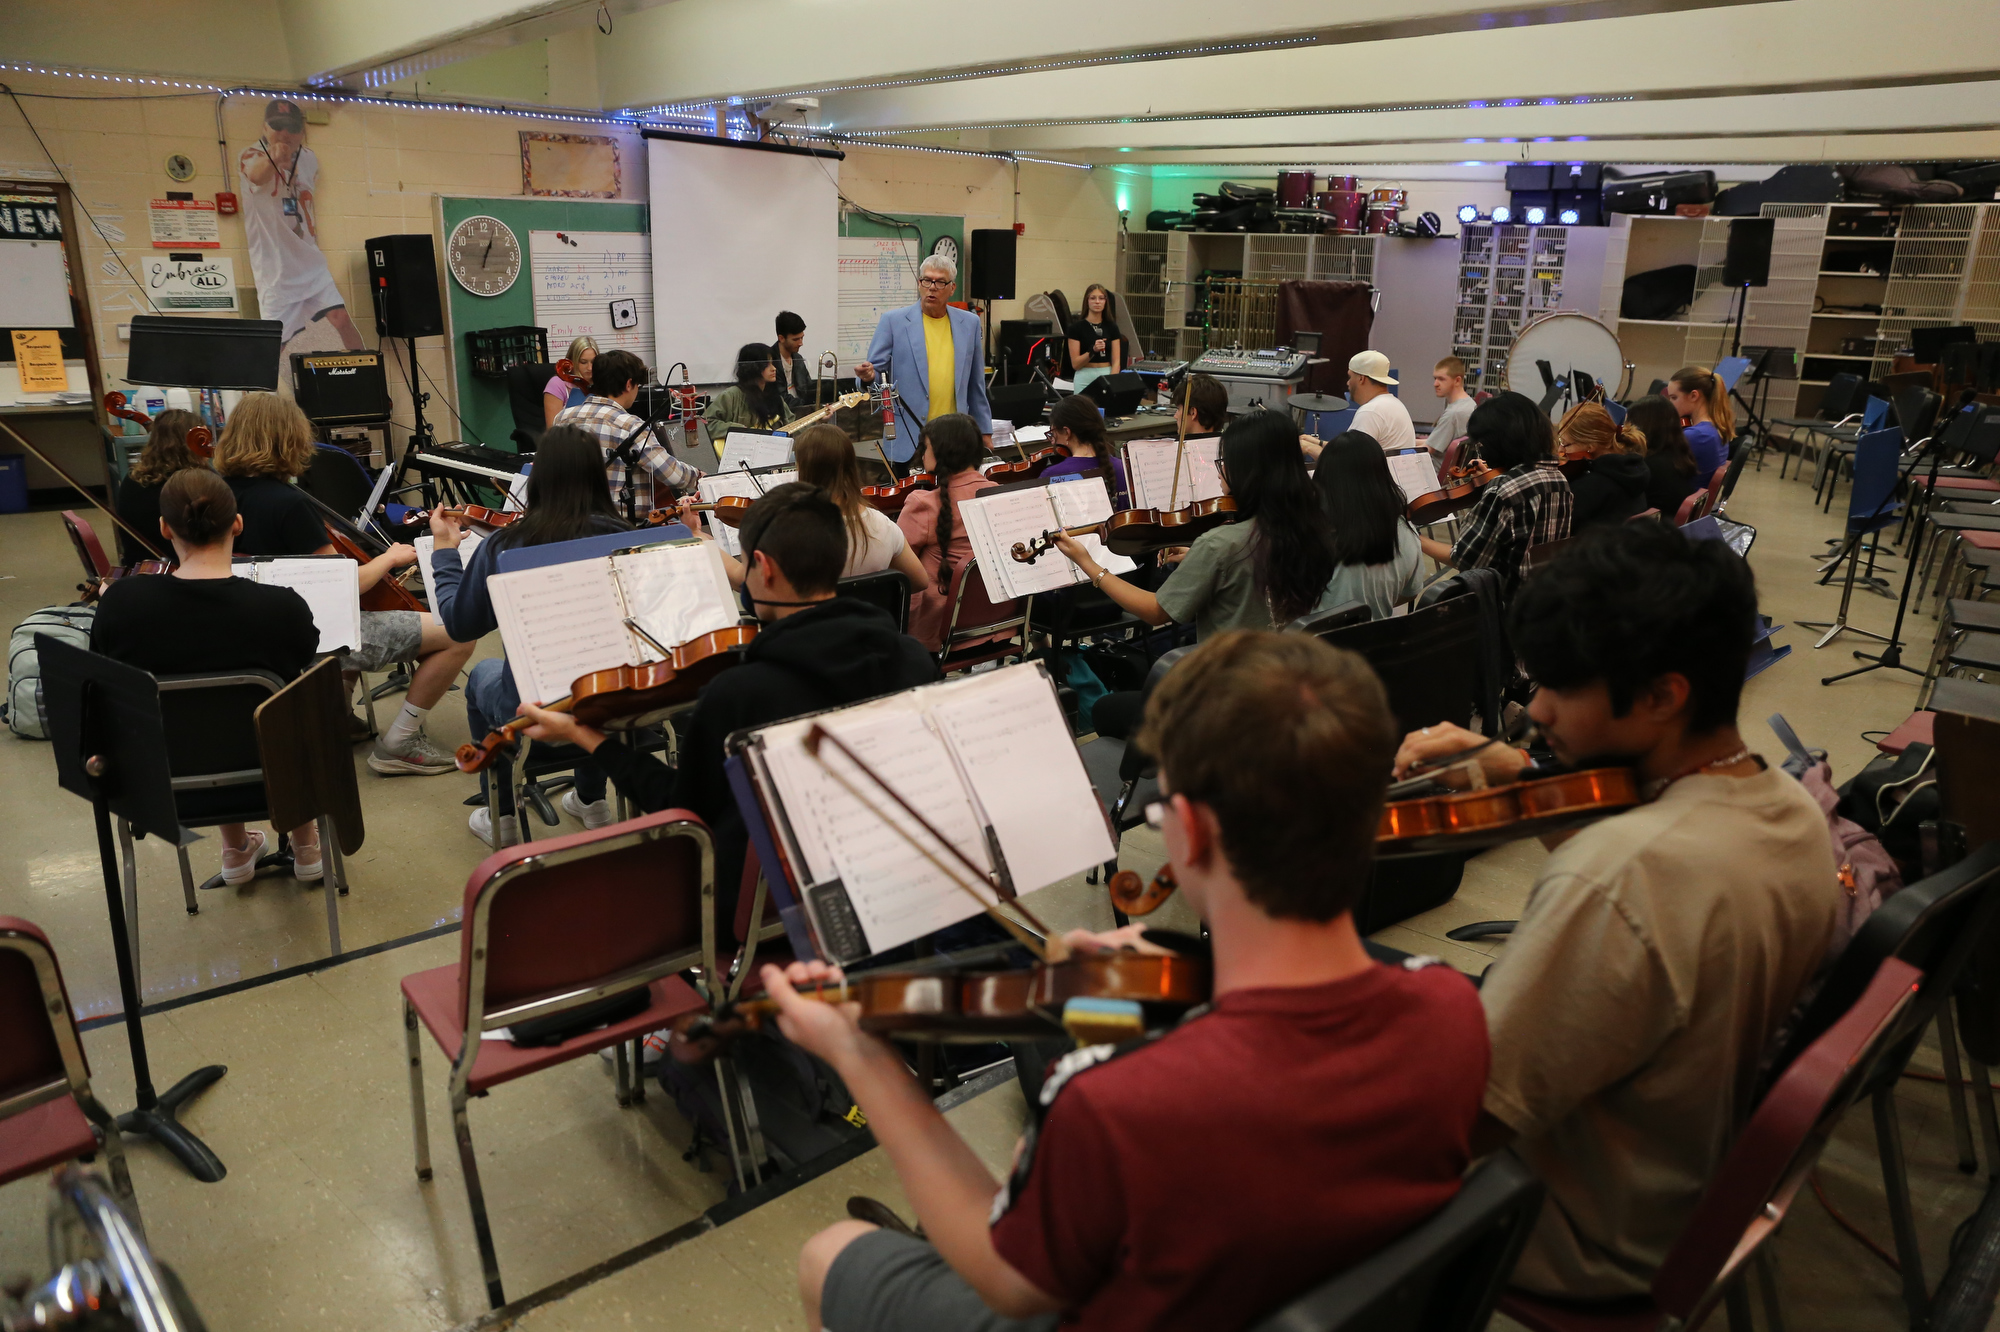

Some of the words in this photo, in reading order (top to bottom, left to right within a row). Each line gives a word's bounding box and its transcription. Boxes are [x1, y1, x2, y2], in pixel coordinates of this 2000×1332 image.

[468, 226, 475, 236] 11
[480, 222, 488, 233] 12
[495, 227, 499, 237] 1
[458, 236, 466, 246] 10
[505, 237, 510, 247] 2
[455, 251, 461, 261] 9
[509, 252, 515, 261] 3
[151, 262, 220, 288] Embrace
[460, 266, 466, 276] 8
[506, 266, 511, 276] 4
[196, 277, 221, 286] ALL
[471, 277, 477, 286] 7
[485, 281, 490, 290] 6
[498, 276, 503, 286] 5
[551, 324, 573, 337] Emily
[328, 368, 357, 376] Marshall
